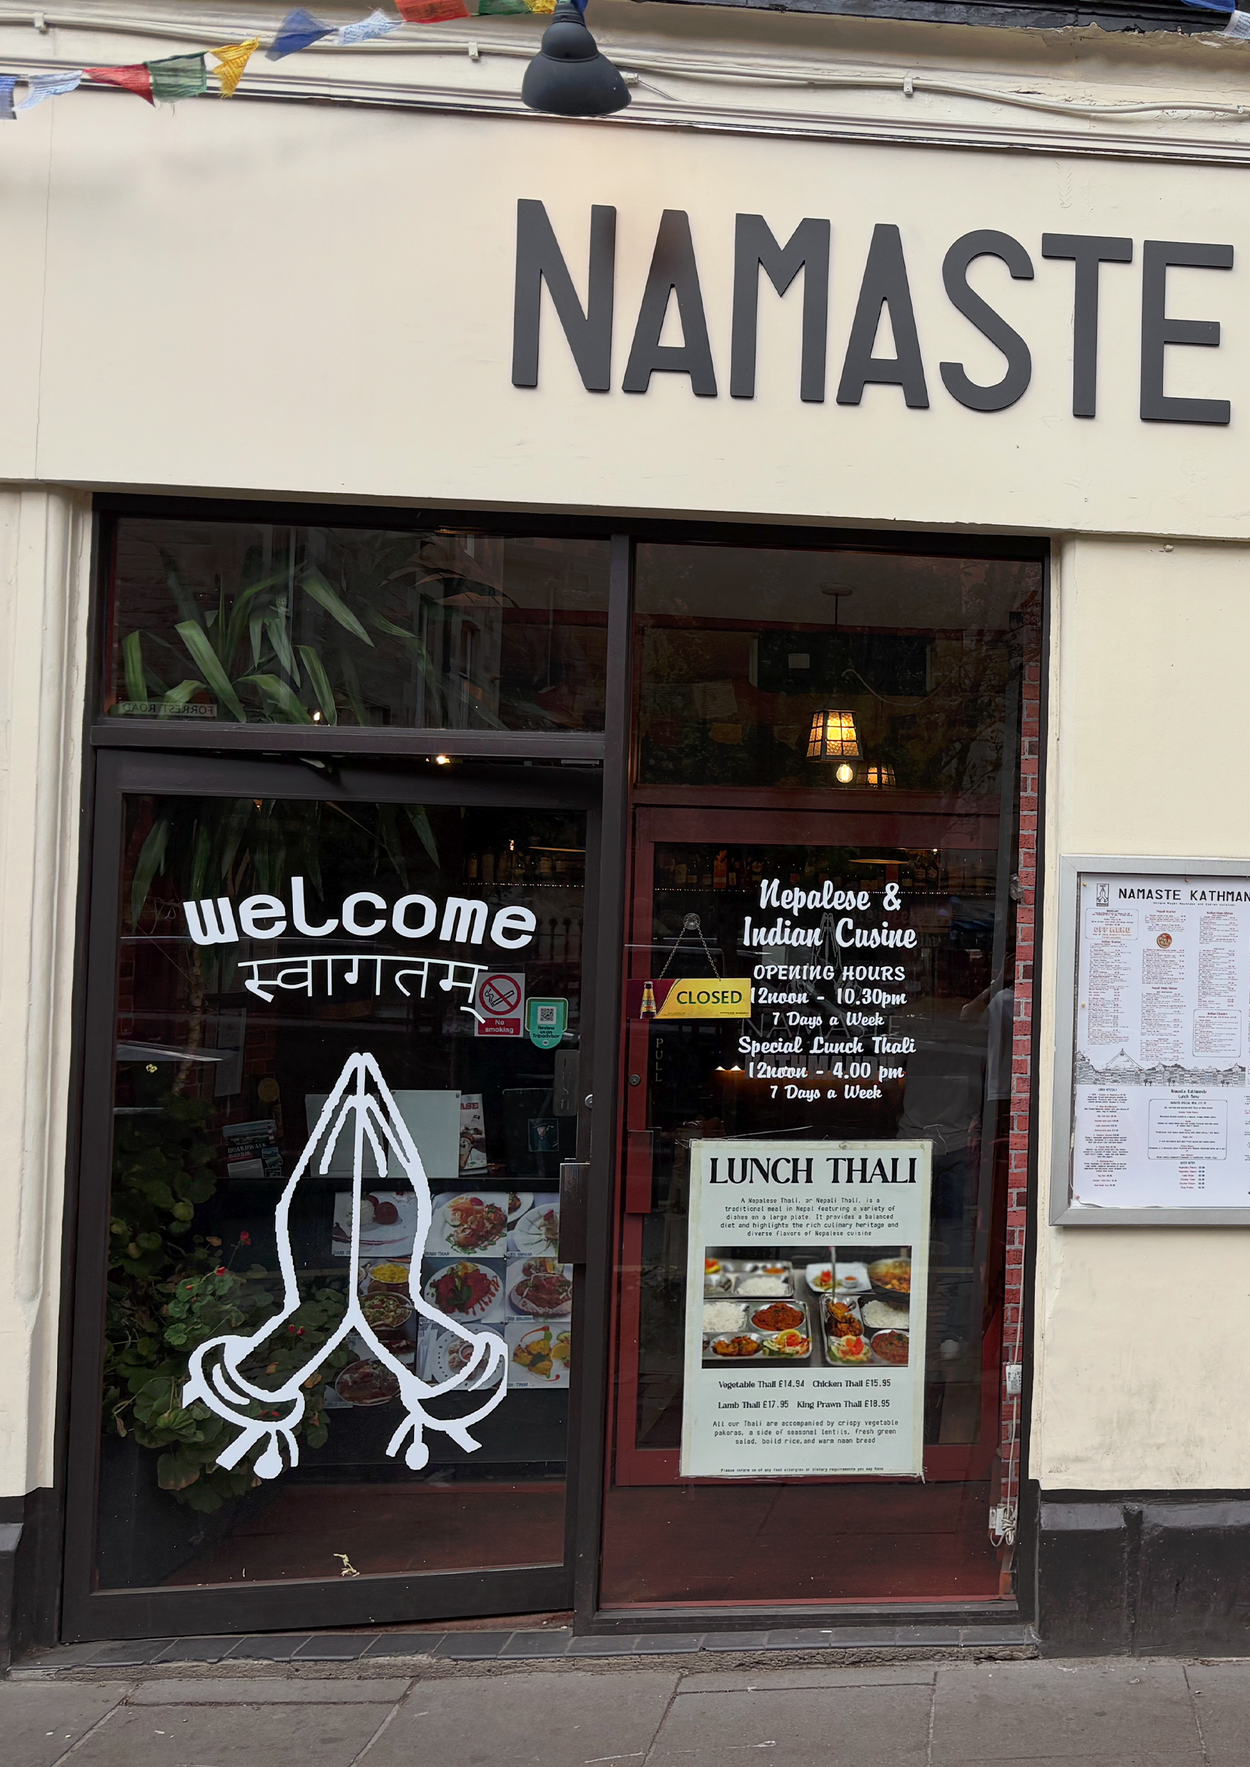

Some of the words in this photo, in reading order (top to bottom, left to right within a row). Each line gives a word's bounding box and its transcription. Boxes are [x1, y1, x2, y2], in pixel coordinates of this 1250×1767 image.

[511, 198, 1234, 428] NAMASTE
[759, 878, 871, 916] Nepalese
[882, 882, 903, 911] &
[1118, 887, 1182, 901] NAMASTE
[182, 875, 538, 950] welcome
[743, 915, 824, 948] Indian
[835, 917, 918, 949] Cusine
[752, 964, 835, 981] OPENING
[842, 965, 906, 981] HOURS
[237, 954, 489, 1024] स्वागतम्
[676, 990, 743, 1005] CLOSED
[750, 986, 810, 1005] 12noon
[837, 987, 908, 1009] 10.30pm
[494, 1018, 505, 1026] No
[772, 1012, 780, 1026] 7
[786, 1012, 823, 1028] Days
[829, 1016, 840, 1026] a
[846, 1011, 885, 1026] Week
[484, 1026, 515, 1035] smoking
[737, 1035, 803, 1057] Special
[810, 1036, 865, 1054] Lunch
[872, 1035, 917, 1055] Thali
[654, 1037, 664, 1082] PULL
[749, 1061, 808, 1079] 12noon
[832, 1061, 871, 1079] 4.00
[878, 1065, 906, 1082] pm
[770, 1085, 778, 1099] 7
[784, 1085, 821, 1102] Days
[827, 1089, 838, 1099] a
[844, 1084, 883, 1099] Week
[709, 1157, 814, 1184] LUNCH
[825, 1157, 918, 1184] THALI
[724, 1205, 765, 1213] traditional
[766, 1205, 782, 1213] meal
[795, 1205, 814, 1213] Nepal
[817, 1205, 850, 1214] featuring
[859, 1204, 886, 1213] variety
[747, 1197, 778, 1205] Nepalese
[815, 1197, 837, 1205] Nepali
[725, 1213, 749, 1221] dishes
[769, 1214, 788, 1222] large
[825, 1213, 855, 1221] provides
[752, 1221, 789, 1230] highlights
[823, 1221, 853, 1230] culinary
[855, 1221, 885, 1230] heritage
[814, 1230, 844, 1238] Nepalese
[718, 1380, 756, 1391] Vegetable
[778, 1379, 805, 1388] £14.94
[865, 1378, 892, 1388] £15.95
[717, 1401, 740, 1410] Lamb
[762, 1399, 789, 1409] £17.95
[816, 1400, 842, 1409] Prawn
[864, 1399, 891, 1408] £18.95
[712, 1420, 725, 1428] All
[743, 1419, 762, 1427] Thali
[781, 1419, 824, 1428] accompanied
[837, 1419, 861, 1429] crispy
[864, 1419, 899, 1428] vegetable
[786, 1428, 817, 1436] seasonal
[854, 1428, 876, 1437] fresh
[876, 1428, 897, 1437] green
